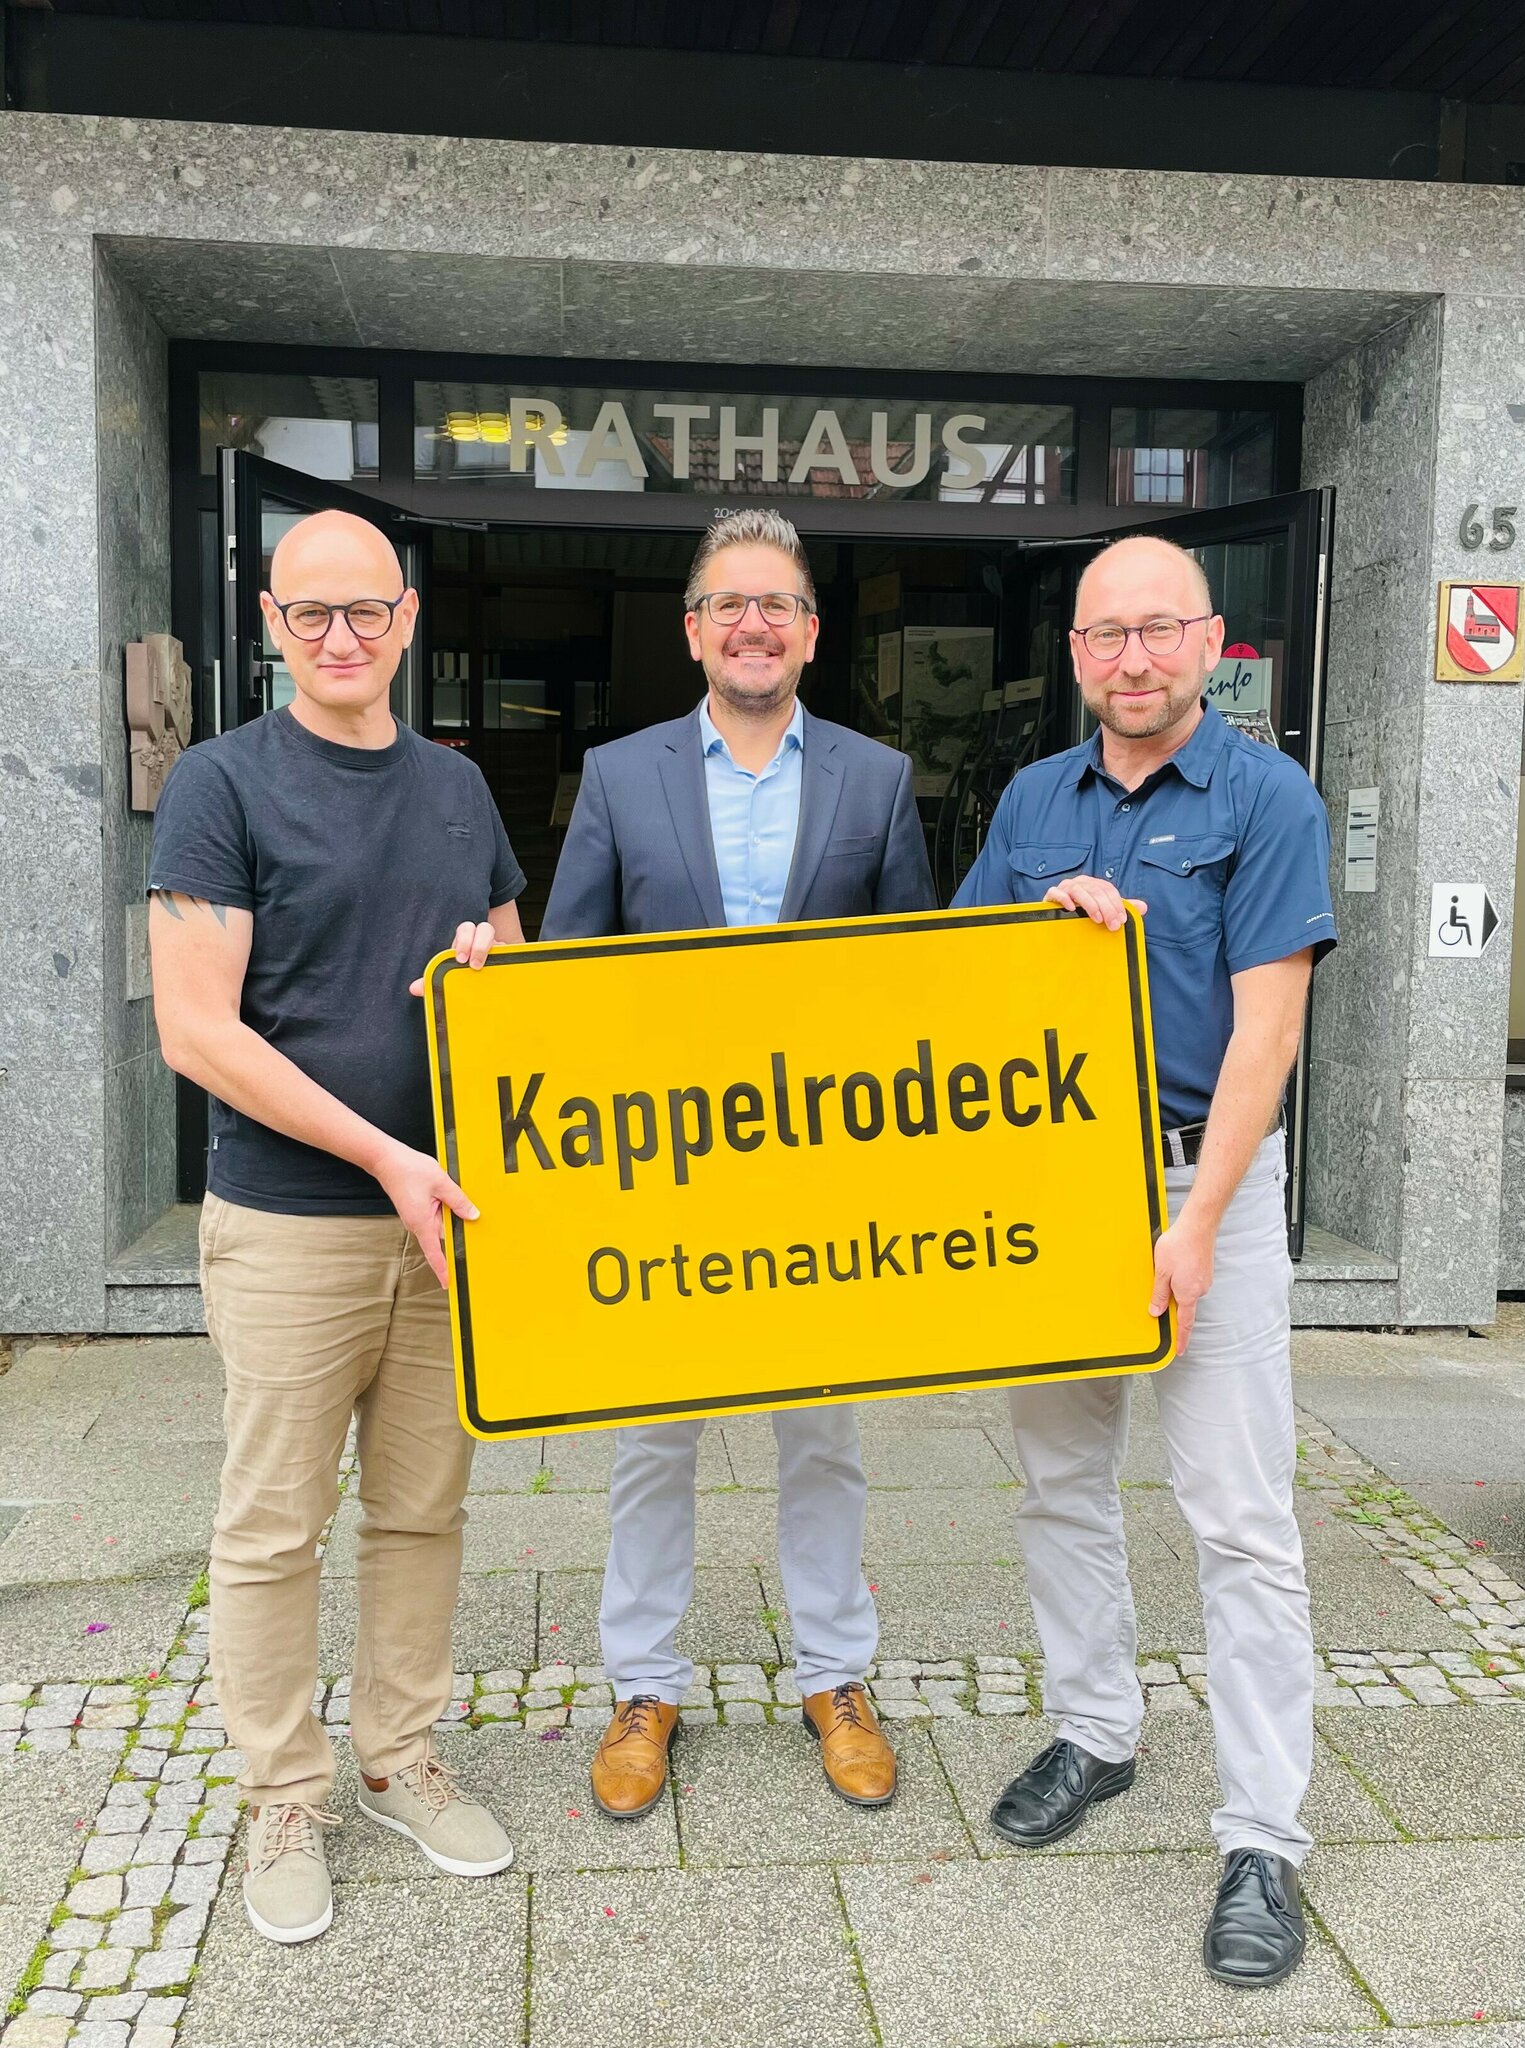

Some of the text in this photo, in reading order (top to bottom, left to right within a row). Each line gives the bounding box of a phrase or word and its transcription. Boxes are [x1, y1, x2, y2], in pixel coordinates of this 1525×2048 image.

[508, 397, 987, 490] RATHAUS
[1459, 504, 1517, 550] 65
[1205, 661, 1252, 700] info
[496, 1028, 1097, 1190] Kappelrodeck
[587, 1211, 1040, 1305] Ortenaukreis
